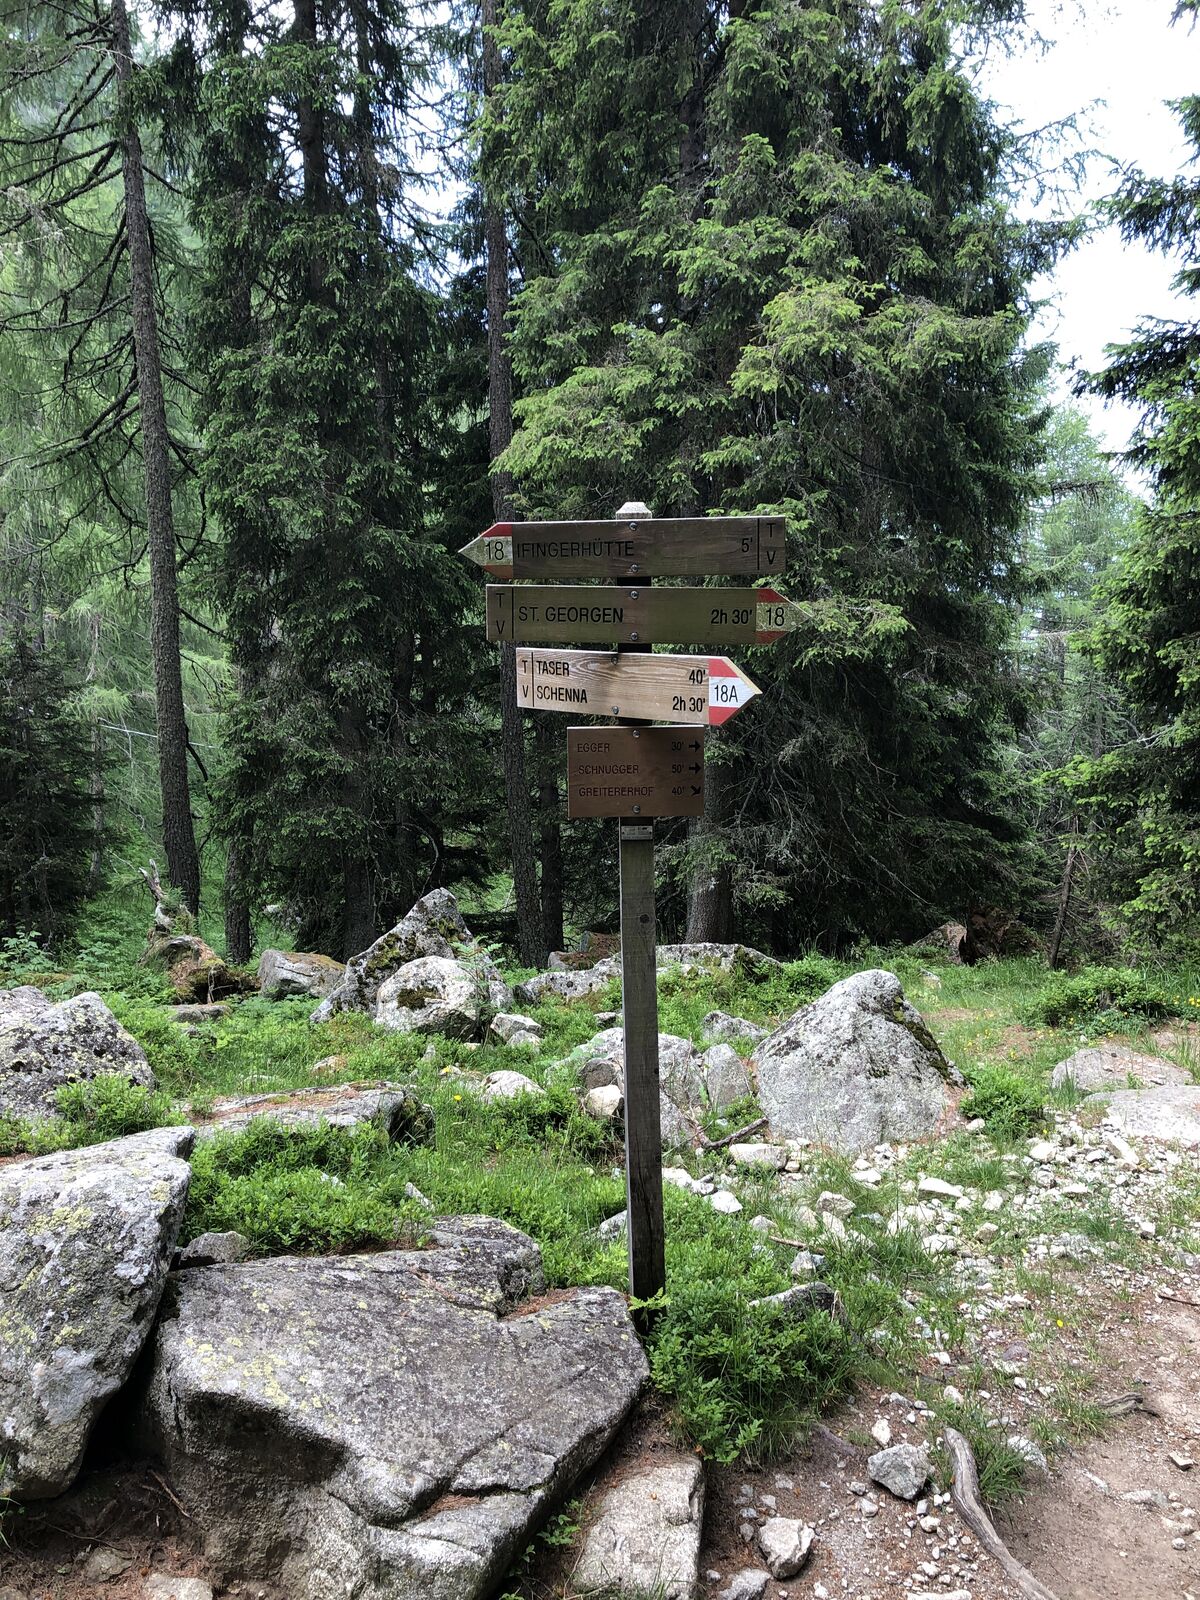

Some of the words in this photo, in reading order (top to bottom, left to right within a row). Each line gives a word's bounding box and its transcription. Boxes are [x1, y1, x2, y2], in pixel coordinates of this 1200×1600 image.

[767, 523, 776, 538] T
[485, 541, 504, 561] 18
[517, 538, 634, 558] IFINGERHÜTTE
[741, 537, 753, 553] 5'
[766, 550, 776, 565] V
[496, 593, 505, 608] T
[518, 606, 540, 622] ST.
[545, 607, 624, 623] GEORGEN
[711, 609, 728, 624] 2h
[732, 609, 753, 625] 30'
[766, 607, 785, 627] 18
[496, 620, 505, 635] V
[521, 660, 528, 674] T
[536, 660, 570, 677] TASER
[689, 669, 706, 685] 40'
[522, 685, 529, 698] V
[536, 685, 588, 704] SCHENNA
[714, 684, 739, 703] 18A
[672, 696, 686, 712] 2h
[689, 697, 706, 713] 30'
[577, 742, 610, 753] EGGER
[578, 764, 639, 775] SCHNUGGER
[578, 786, 656, 797] GREITERERHOF
